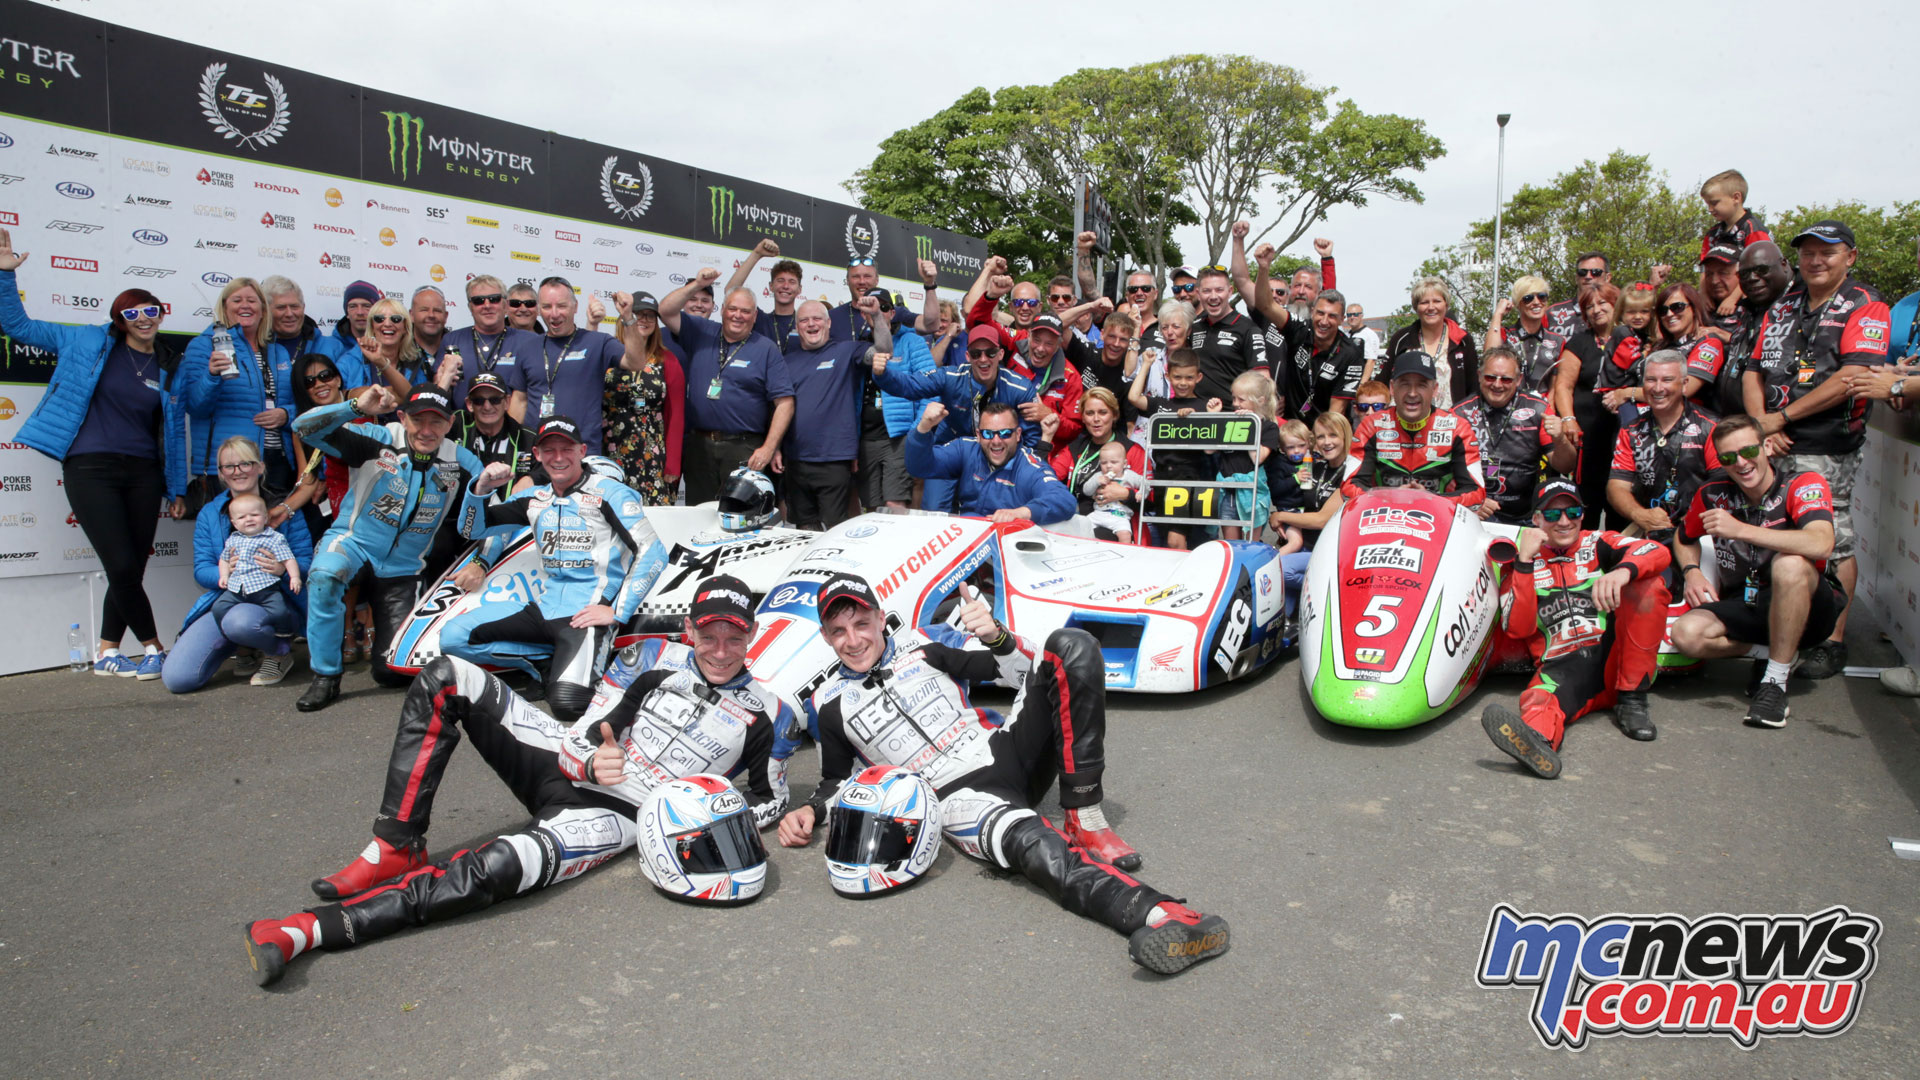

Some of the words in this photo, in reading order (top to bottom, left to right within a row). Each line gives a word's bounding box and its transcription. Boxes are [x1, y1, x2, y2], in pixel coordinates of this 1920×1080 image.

[225, 84, 268, 107] TT
[60, 146, 98, 158] WRYST
[428, 135, 535, 175] MONSTER
[211, 170, 234, 181] POKER
[446, 162, 520, 184] ENERGY
[615, 171, 641, 189] TT
[62, 182, 90, 196] Arai
[211, 178, 234, 188] STARS
[254, 182, 300, 195] HONDA
[137, 196, 172, 206] WRYST
[380, 204, 410, 214] Bennetts
[274, 214, 295, 223] POKER
[736, 203, 804, 231] MONSTER
[45, 220, 104, 234] RST
[274, 221, 295, 231] STARS
[313, 223, 355, 235] HONDA
[747, 224, 794, 239] ENERGY
[854, 226, 872, 239] TT
[138, 230, 164, 244] Arai
[556, 232, 580, 242] MOTUL
[206, 240, 238, 249] WRYST
[431, 241, 459, 251] Bennetts
[53, 257, 98, 271] MOTUL
[331, 254, 351, 263] POKER
[331, 261, 351, 270] STARS
[933, 249, 981, 270] MONSTER
[122, 266, 177, 278] RST
[368, 262, 408, 273] HONDA
[595, 264, 618, 273] MOTUL
[940, 266, 975, 277] ENERGY
[1761, 351, 1782, 359] OTOR
[1158, 423, 1217, 440] Birchall
[1223, 421, 1252, 443] 16
[1428, 431, 1451, 443] 151s
[3, 476, 32, 484] POKER
[4, 484, 32, 492] STARS
[1359, 507, 1435, 533] H&S
[0, 551, 39, 559] WRYST
[155, 548, 179, 556] STARS
[875, 524, 963, 602] MITCHELLS
[1359, 556, 1415, 567] CANCER
[938, 544, 992, 594] www.i-e-g.com
[1346, 575, 1374, 587] carl
[1395, 577, 1422, 590] cox
[706, 589, 750, 605] AVON
[1116, 585, 1159, 603] MOTUL
[1354, 594, 1404, 637] 5
[1214, 599, 1252, 674] IEG
[1444, 605, 1470, 658] carl
[739, 690, 761, 708] Arai
[720, 698, 757, 726] MOTUL
[888, 729, 916, 752] One
[919, 706, 945, 728] Call
[641, 726, 665, 750] One
[670, 747, 697, 770] Call
[622, 738, 674, 784] MITCHELL
[844, 787, 874, 801] Arai
[714, 795, 743, 813] Arai
[566, 824, 590, 835] One
[916, 831, 935, 866] One
[928, 793, 941, 826] Call
[645, 811, 657, 850] One
[656, 853, 679, 884] Call
